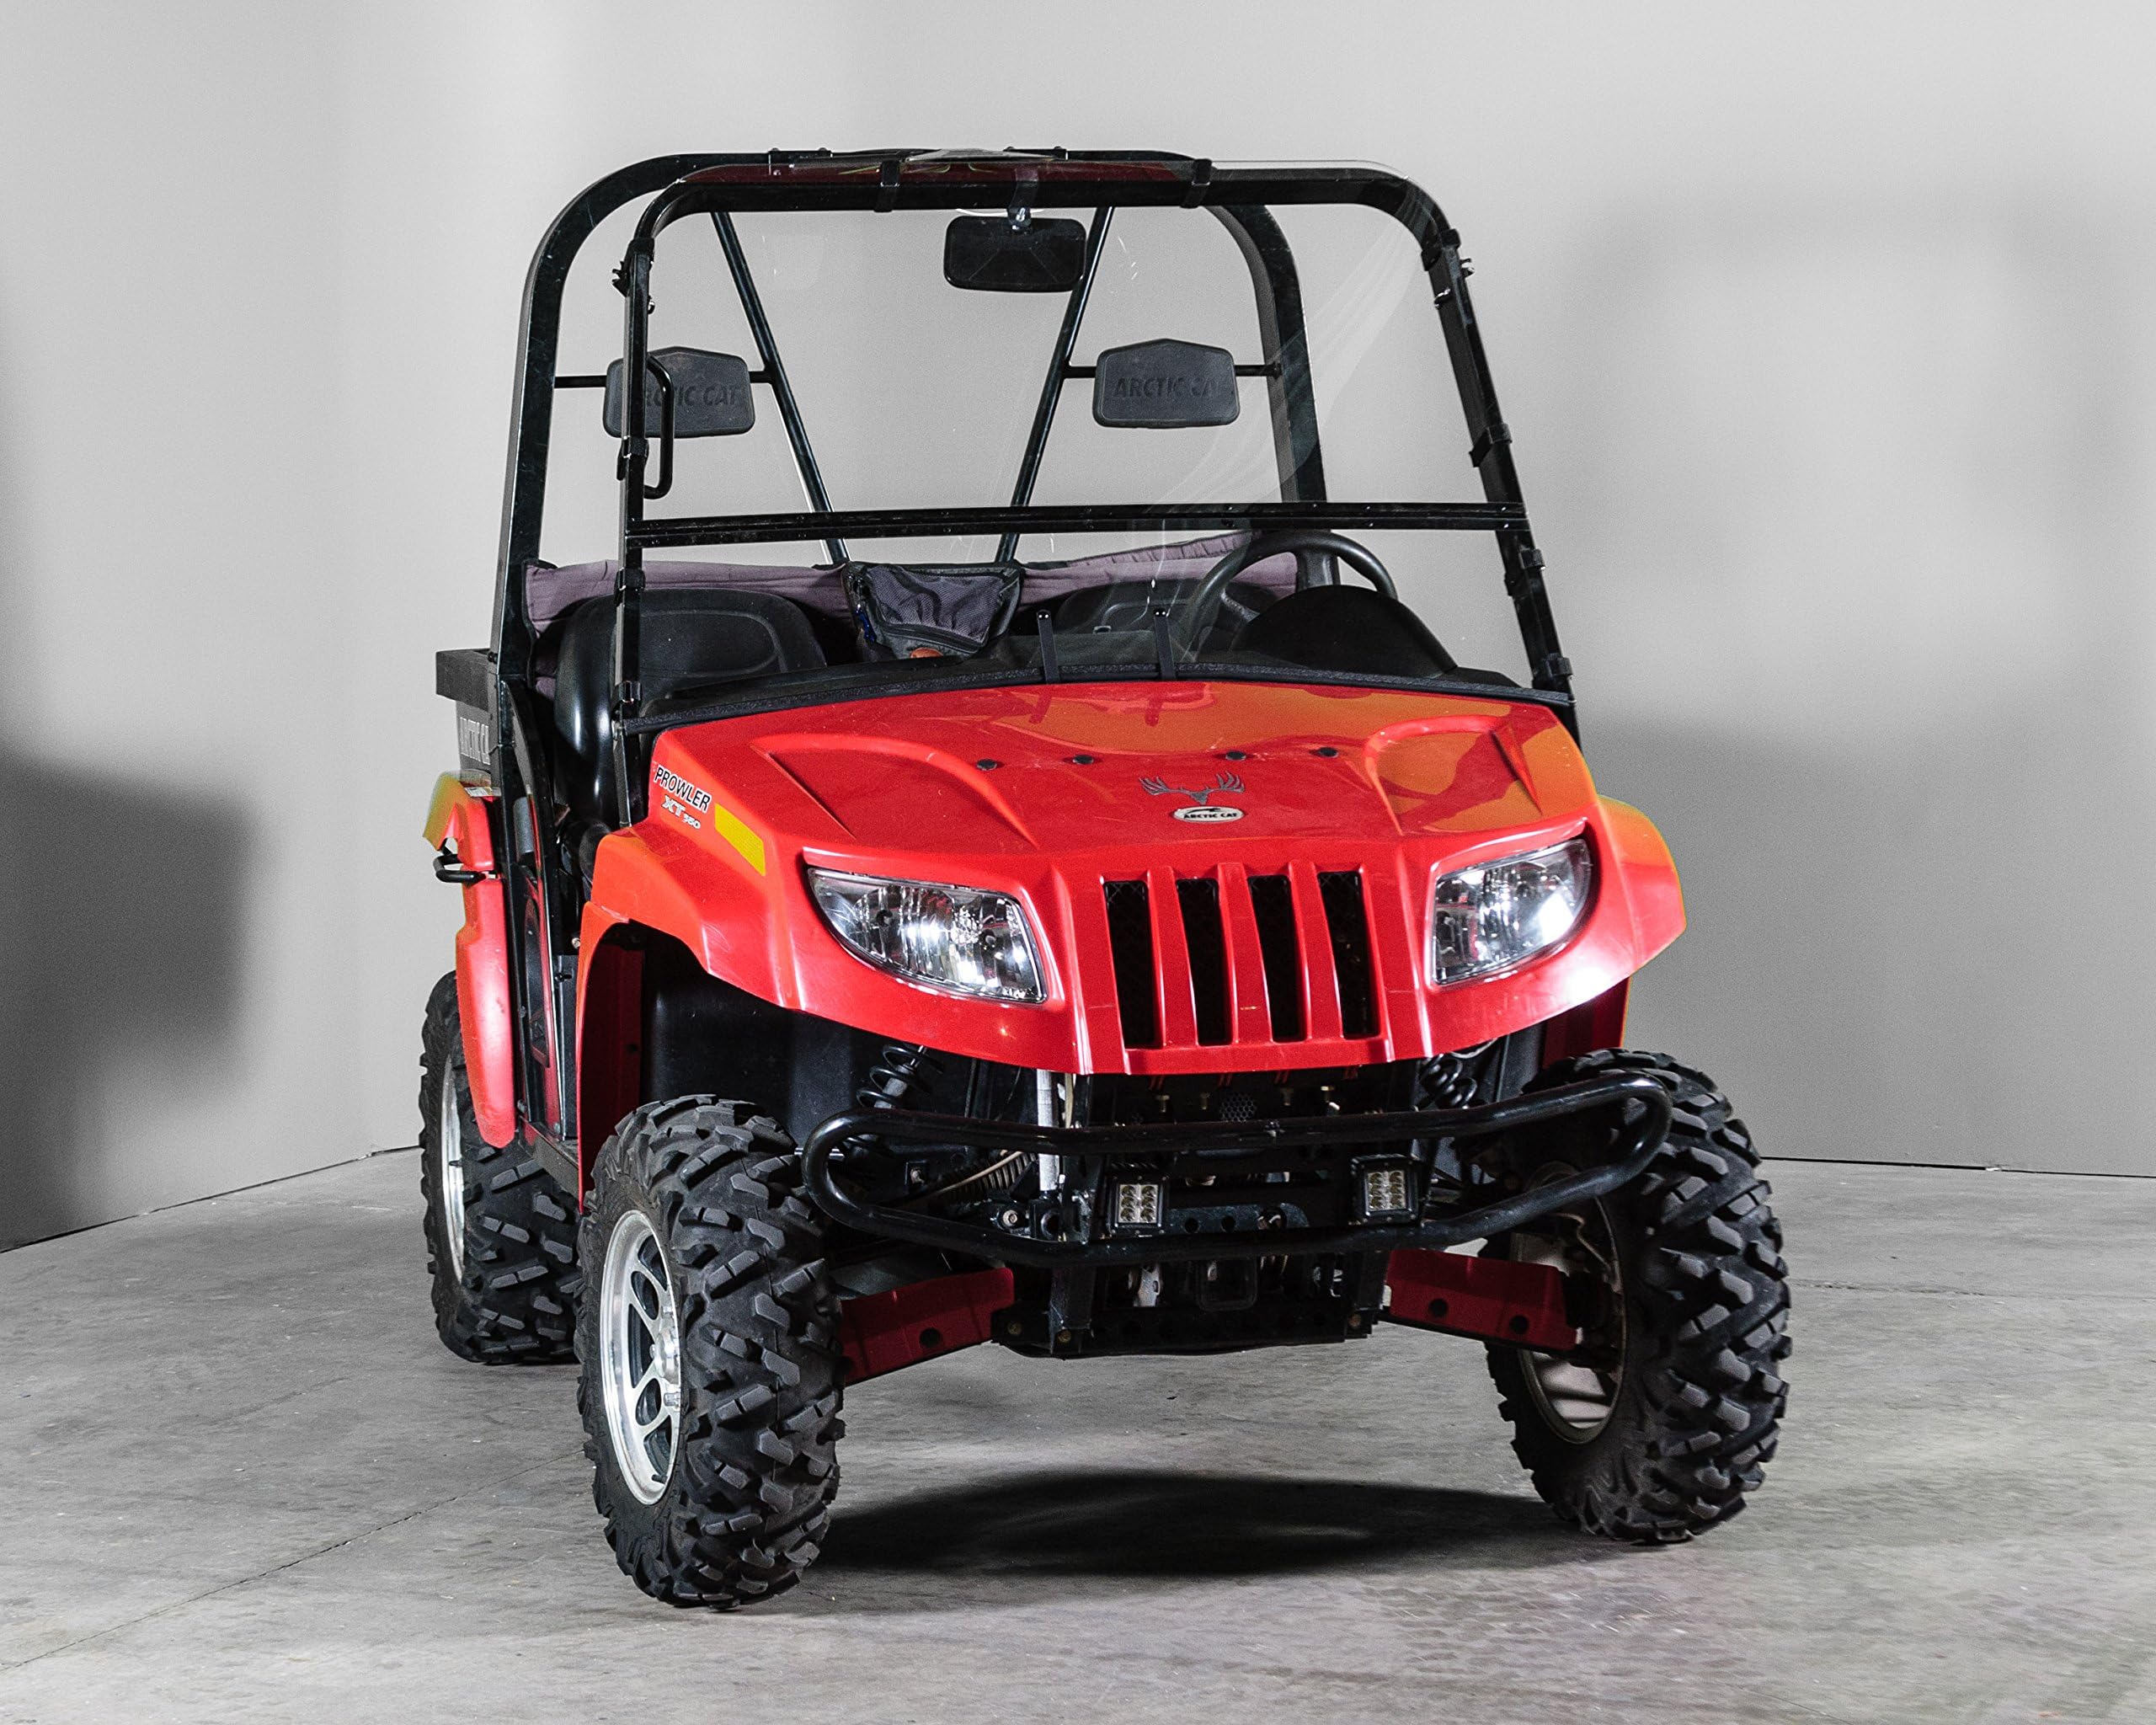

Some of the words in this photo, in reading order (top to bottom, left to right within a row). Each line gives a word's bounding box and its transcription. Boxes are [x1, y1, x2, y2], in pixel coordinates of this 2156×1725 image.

[703, 385, 739, 406] CAT
[1114, 377, 1186, 398] ARCTIC
[654, 766, 712, 813] PROWLER
[662, 794, 686, 817] XT
